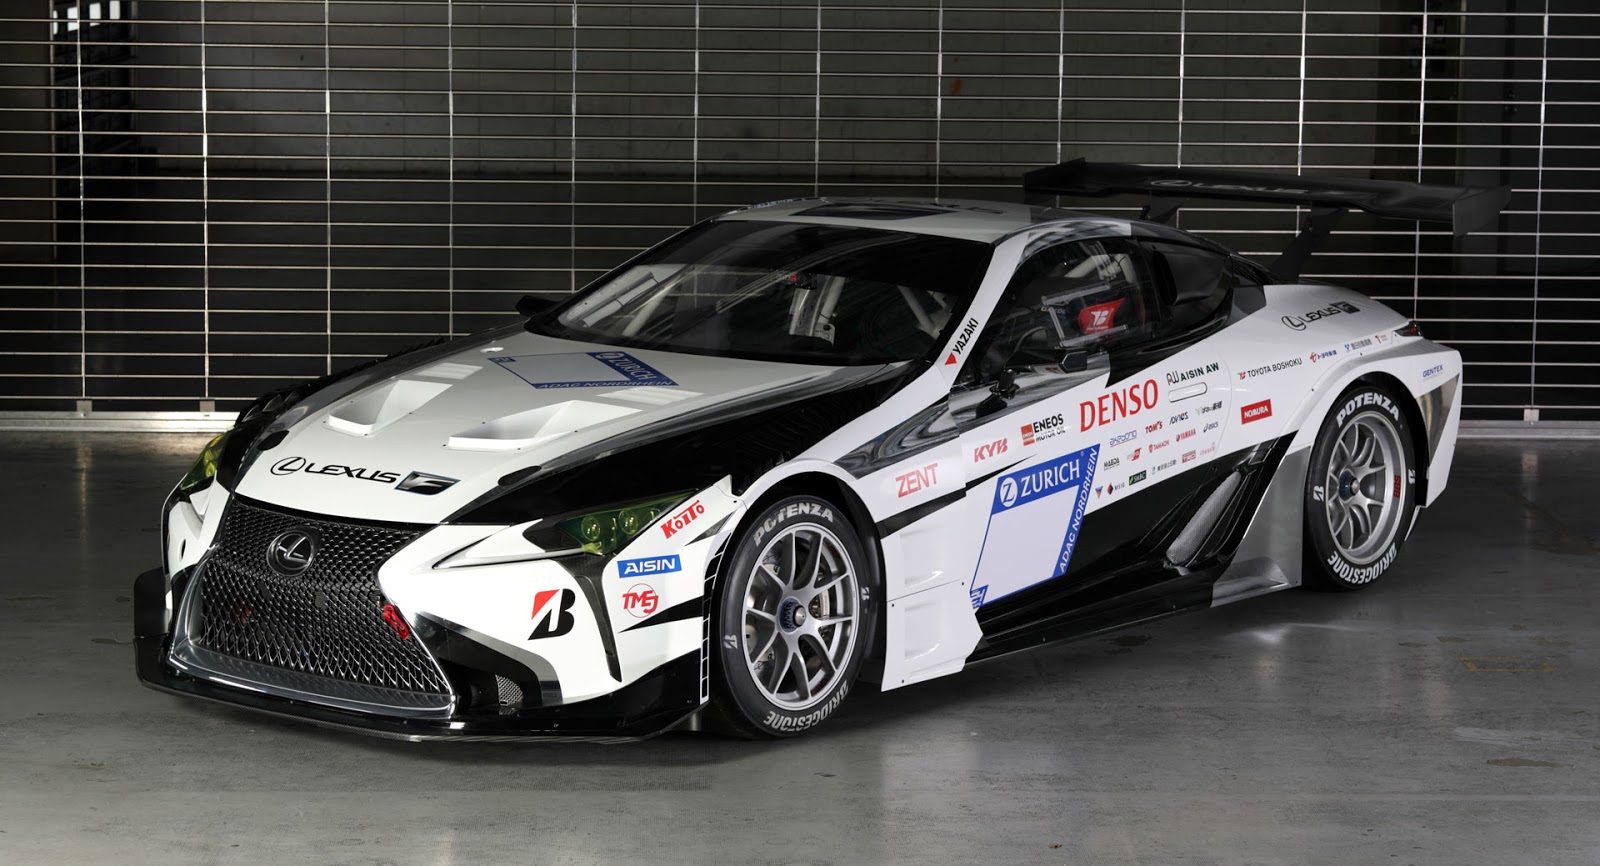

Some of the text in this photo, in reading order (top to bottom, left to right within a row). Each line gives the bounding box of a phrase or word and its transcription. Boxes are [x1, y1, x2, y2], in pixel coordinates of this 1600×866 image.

[1298, 307, 1341, 323] LEXUS
[952, 318, 979, 355] YAZAKI
[611, 356, 658, 381] ZURICH
[1181, 366, 1205, 381] AISIN
[1206, 362, 1219, 374] AW
[1247, 366, 1272, 378] TOYOTA
[1272, 357, 1303, 372] BOSHOKU
[1423, 364, 1443, 377] GENTEX
[537, 380, 673, 389] ADAC NORDRHEIN
[1079, 379, 1159, 433] DENSO
[1244, 404, 1269, 419] NOMURA
[1336, 392, 1400, 428] POTENZA
[1033, 413, 1064, 434] ENEOS
[973, 438, 1009, 463] KYB
[304, 463, 402, 484] LEXUS
[895, 463, 938, 499] ZENT
[1020, 459, 1080, 498] ZURICH
[1059, 447, 1098, 573] ADAC NORDRHEIN
[752, 502, 834, 547] POTENZA
[624, 558, 677, 575] AISIN
[1327, 541, 1398, 585] BRIDGESTONE
[763, 679, 849, 732] BRIDGESTONE
